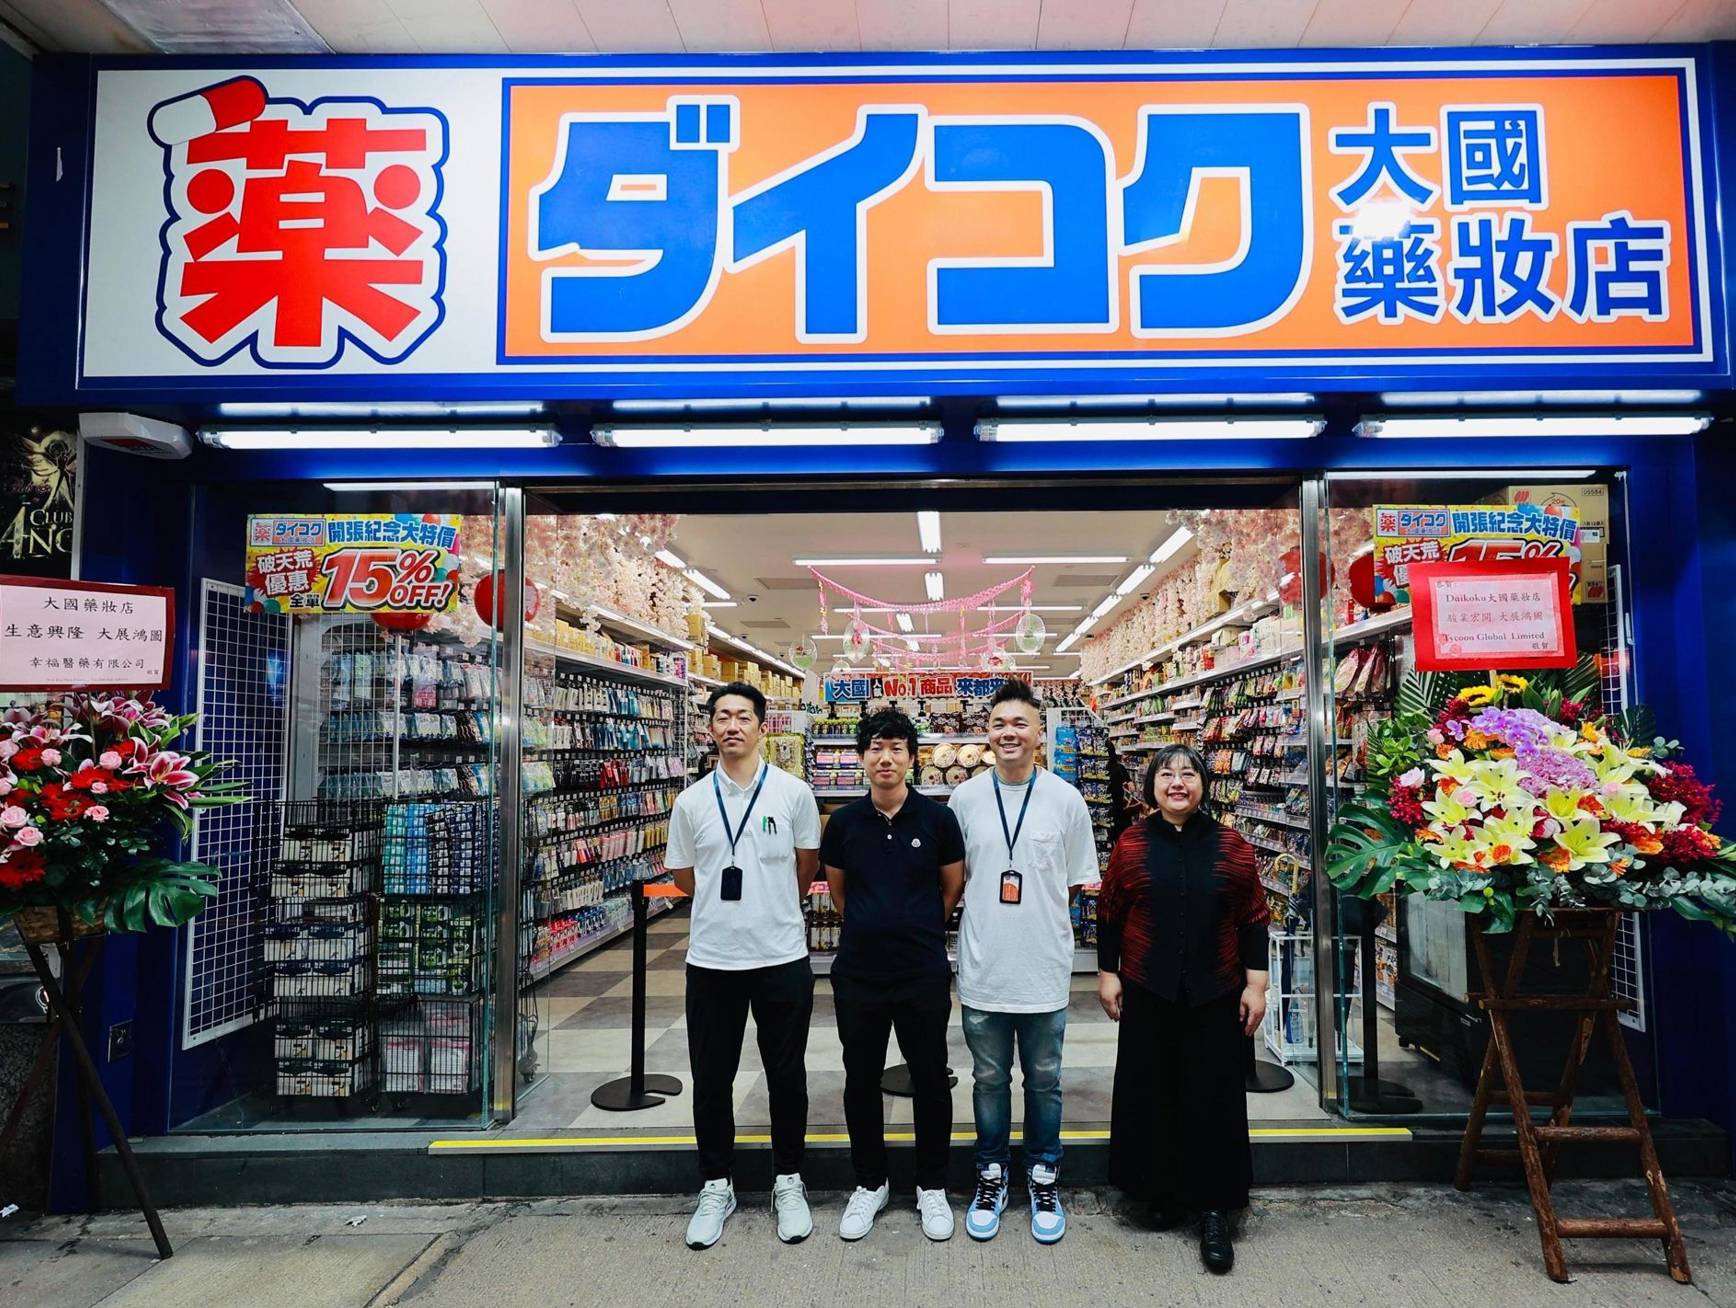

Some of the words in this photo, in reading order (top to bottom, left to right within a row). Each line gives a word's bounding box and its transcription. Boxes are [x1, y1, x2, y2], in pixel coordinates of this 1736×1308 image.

[1334, 106, 1543, 207] 大國
[538, 100, 1302, 336] ダイコク
[1336, 214, 1666, 319] 藥妝店
[328, 520, 457, 549] 開張紀念大特價
[1452, 511, 1578, 542] 開張紀念大特價
[257, 550, 314, 574] 破天荒
[1385, 541, 1441, 564] 破天荒
[265, 571, 310, 595] 優惠
[44, 597, 135, 615] 大國藥妝店
[290, 593, 321, 609] 全單
[390, 583, 451, 608] OFF!
[4, 623, 85, 640] 生意興隆
[97, 628, 163, 643] 大展鴻圖
[1476, 632, 1507, 642] Global
[1511, 631, 1546, 641] Limited
[30, 657, 145, 670] 幸福醫藥有限公司
